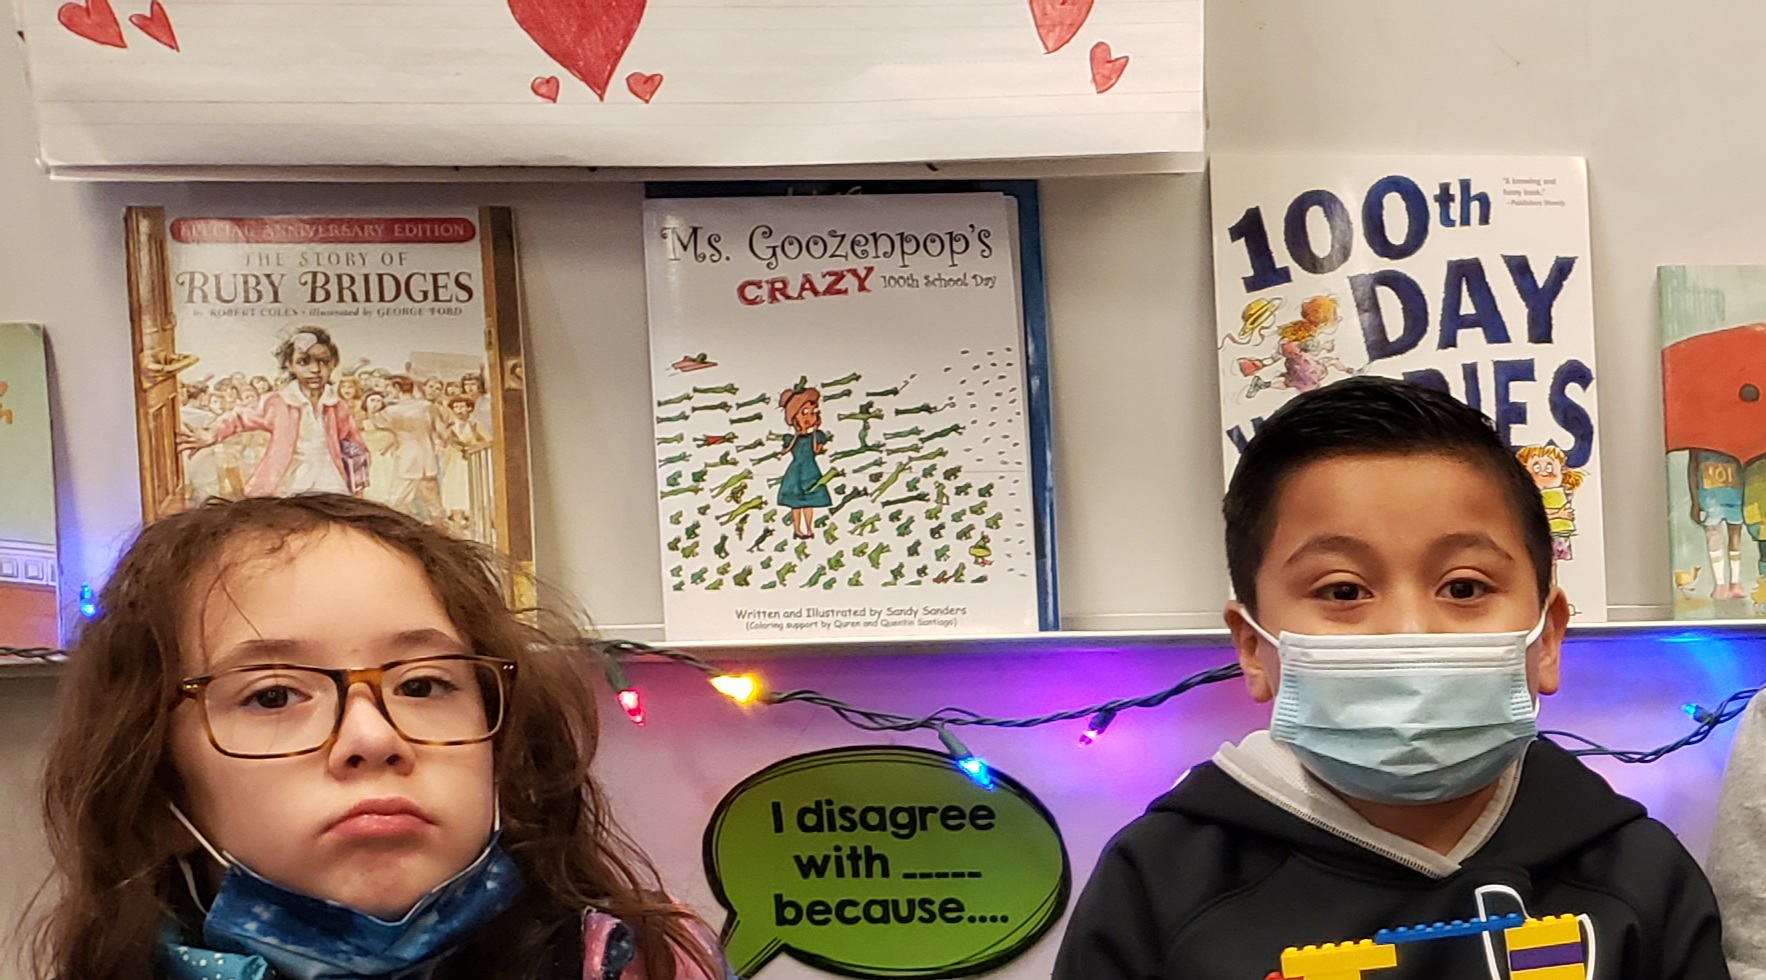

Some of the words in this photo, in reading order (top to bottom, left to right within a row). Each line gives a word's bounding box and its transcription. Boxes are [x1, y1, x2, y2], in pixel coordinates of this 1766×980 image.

[180, 223, 251, 240] SPECIAL
[263, 223, 384, 239] ANNIVERSARY
[393, 222, 465, 237] EDITION
[661, 225, 731, 264] Ms.
[748, 223, 994, 270] Goozenpop's
[1228, 174, 1492, 294] 100th
[244, 251, 285, 267] THE
[299, 251, 368, 267] STORY
[381, 251, 408, 267] OF
[175, 270, 287, 304] RUBY
[298, 270, 474, 304] BRIDGES
[736, 265, 876, 306] CRAZY
[880, 272, 920, 289] 100th
[923, 271, 969, 289] School
[971, 273, 997, 290] Day
[377, 306, 425, 318] GEORGE
[1346, 253, 1579, 362] DAY
[735, 608, 781, 620] Written
[783, 607, 802, 619] and
[805, 606, 866, 619] Illustrated
[869, 606, 883, 620] by
[886, 604, 919, 619] Sandy
[922, 604, 968, 617] Sanders
[745, 620, 784, 632] (Coloring
[786, 620, 819, 632] support
[820, 620, 832, 631] by
[771, 800, 784, 834] I
[796, 799, 996, 840] disagree
[793, 845, 890, 879] with
[774, 892, 1010, 927] because....
